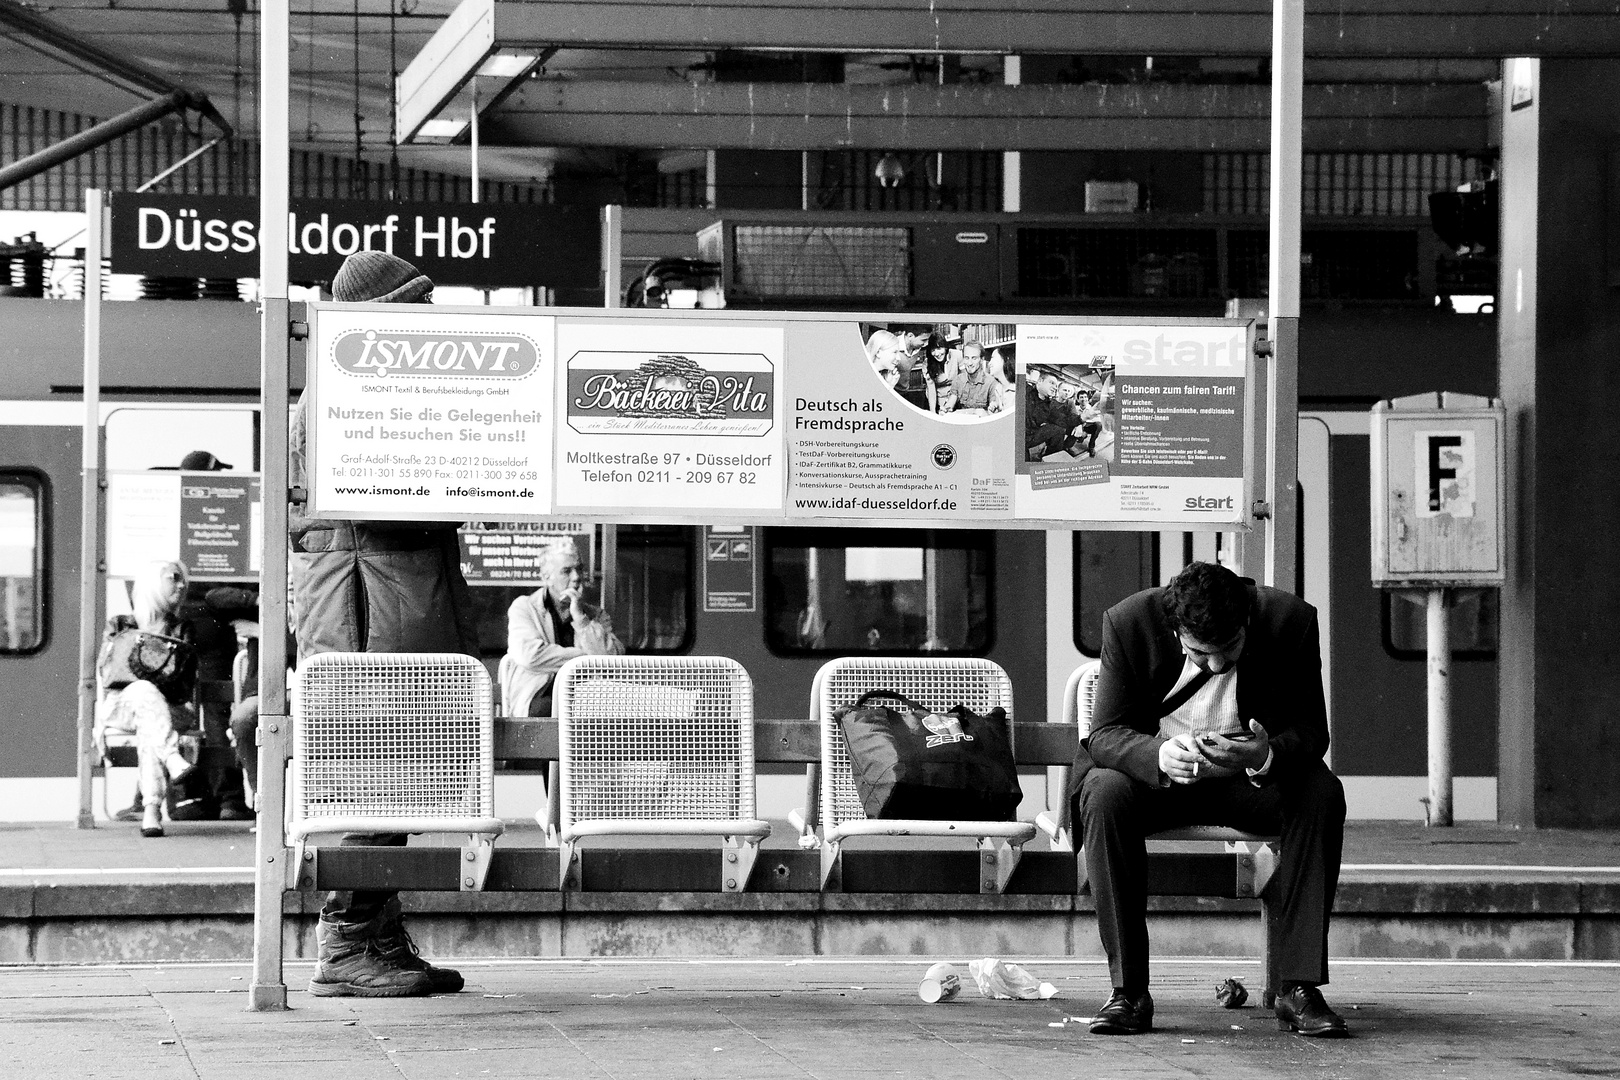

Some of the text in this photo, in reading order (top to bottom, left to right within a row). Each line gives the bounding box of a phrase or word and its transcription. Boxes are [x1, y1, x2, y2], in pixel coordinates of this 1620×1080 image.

[138, 207, 495, 259] Düssldorf Hbf
[1122, 333, 1246, 366] start
[395, 386, 412, 394] Textil
[423, 387, 484, 396] Berufsbekleidungs
[575, 374, 767, 412] Bäckerei Vita
[1122, 385, 1235, 395] Chancen zum fairen Tarif!
[796, 398, 882, 412] Deutsch als
[328, 407, 542, 425] Nutzen Sie die Gelegenheit
[603, 419, 630, 429] Stück
[687, 421, 717, 430] Leben
[796, 417, 904, 433] Fremdsprache
[344, 426, 525, 442] und besuchen Sie uns!!
[800, 441, 879, 449] DSH-Vorbereitungskurse
[341, 455, 528, 467] Graf-Adolf-Straße 23 D-40212 Düsseldorf
[567, 452, 772, 466] Moltkestraße 97 Düsseldorf
[800, 451, 890, 460] TestDaF-Vorbereitungskurse
[333, 468, 537, 480] Tel: 0211-301 55 890 Fax: 0211-300 39 658
[582, 470, 632, 482] Telefon
[638, 471, 670, 483] 0211
[686, 472, 712, 483] 209
[717, 472, 733, 484] 67
[739, 472, 756, 484] 82
[865, 473, 927, 481] Aussprachetraining
[1428, 436, 1461, 511] F
[335, 486, 534, 498] www.ismont.de info@ismont.de
[796, 498, 957, 511] www.idaf-duesseldorf.de
[1185, 495, 1234, 509] start
